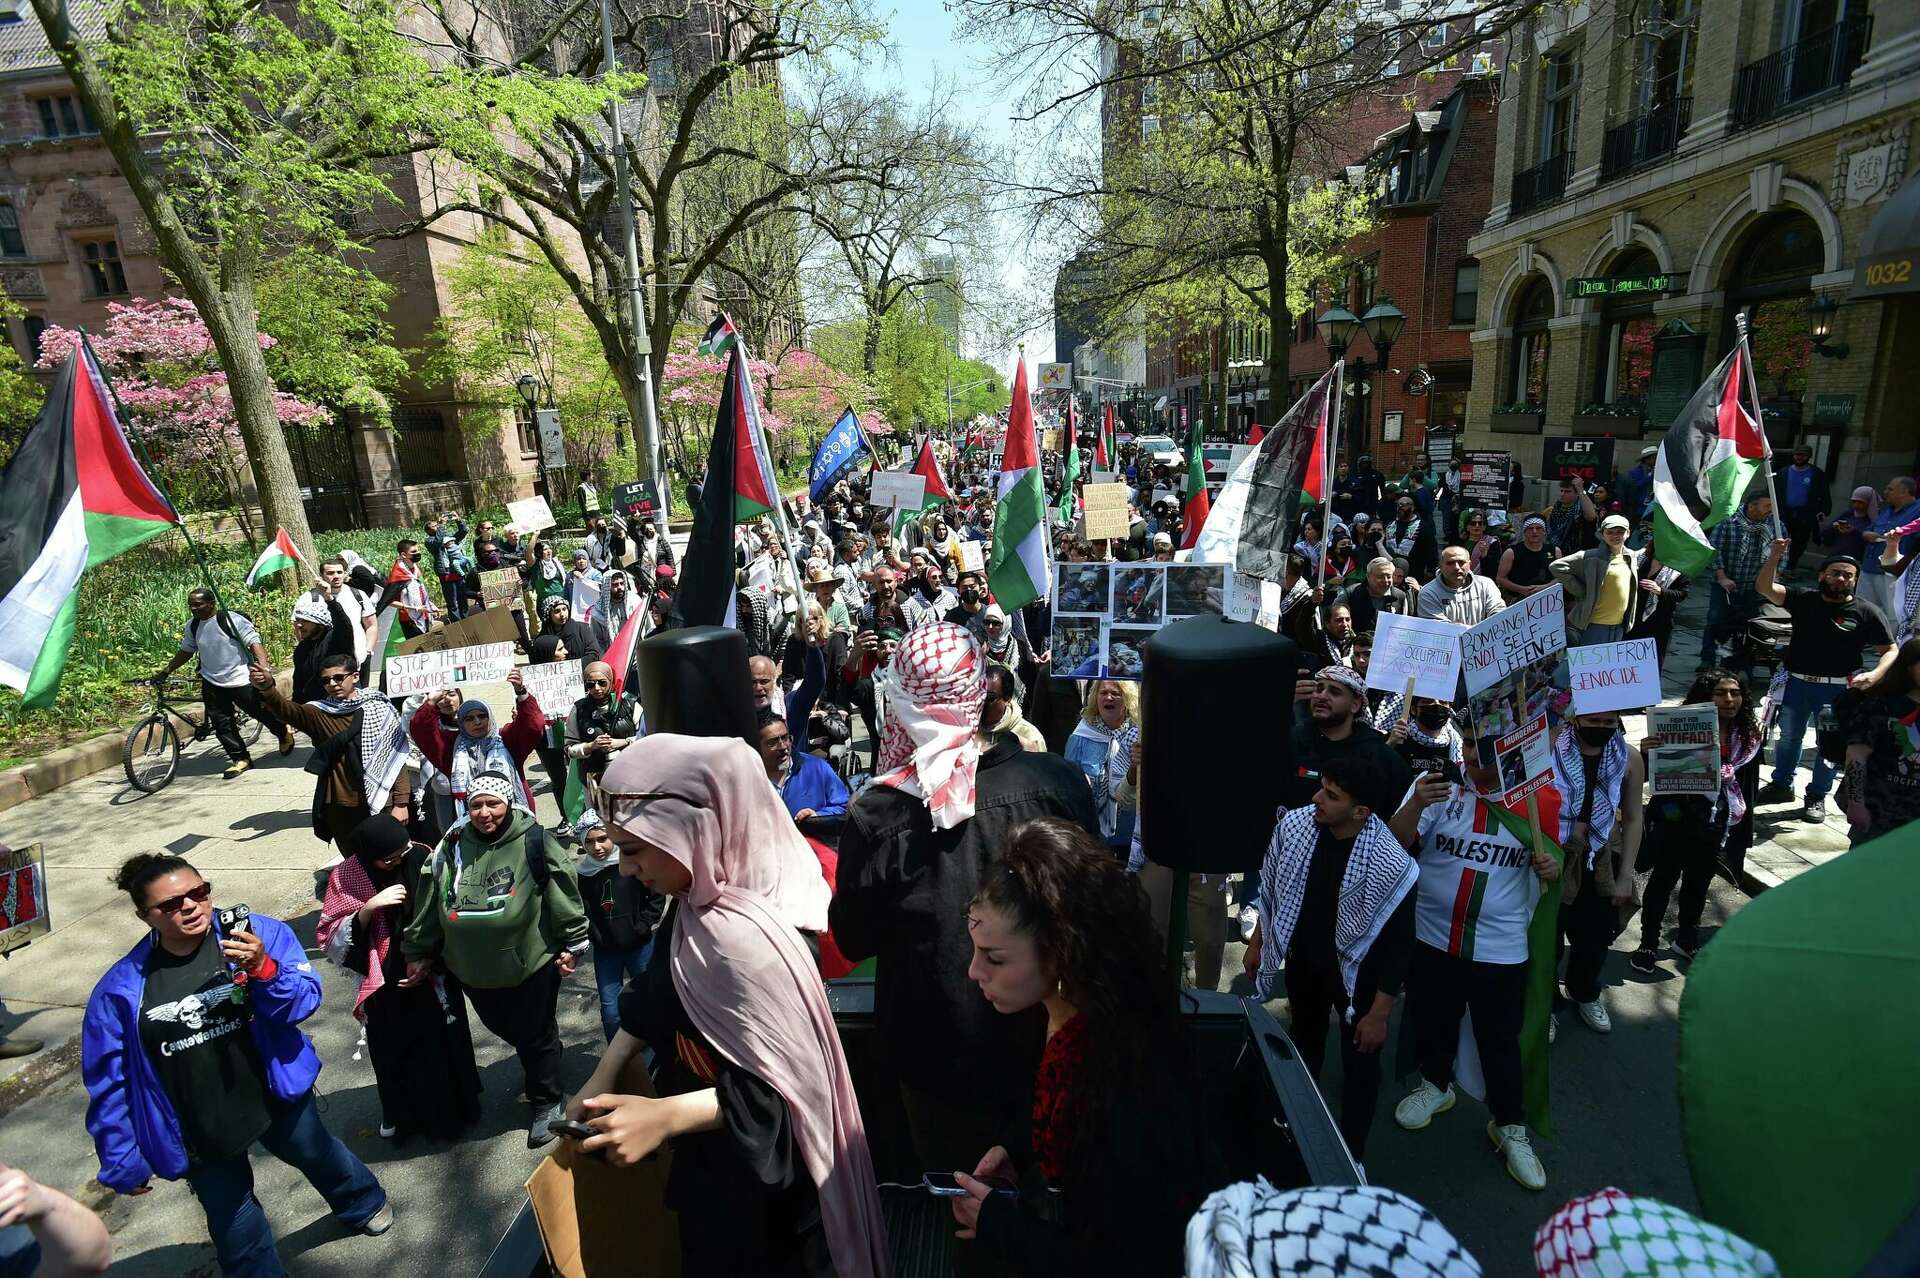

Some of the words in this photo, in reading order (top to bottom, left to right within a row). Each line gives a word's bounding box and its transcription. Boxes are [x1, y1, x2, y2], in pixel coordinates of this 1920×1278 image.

[1865, 260, 1911, 287] 1032
[1564, 441, 1594, 452] LET
[1555, 454, 1600, 465] GAZA
[1559, 466, 1596, 477] LIVE
[624, 491, 652, 503] GAZA
[626, 483, 644, 494] LET
[628, 500, 651, 513] LIVE
[1525, 589, 1564, 622] KIDS
[1404, 646, 1453, 666] OCCUPATION
[1464, 660, 1474, 672] IS
[1473, 646, 1497, 669] NOT
[1497, 629, 1562, 678] DEFENSE
[1568, 645, 1612, 668] VEST
[1617, 639, 1657, 663] FROM
[390, 655, 430, 676] STOP
[437, 650, 460, 668] THE
[469, 661, 496, 671] FREE
[570, 660, 581, 673] IS
[389, 671, 450, 694] GENOCIDE
[470, 668, 509, 681] PALESTI
[564, 674, 585, 688] WHEN
[1570, 666, 1641, 691] GENOCIDE
[552, 688, 569, 699] ARE
[1503, 720, 1540, 748] MURDERED
[1656, 722, 1713, 732] WORLDWIDE
[1510, 789, 1524, 802] FREE
[1523, 773, 1551, 794] PALESTINE
[1435, 833, 1528, 868] PALESTINE
